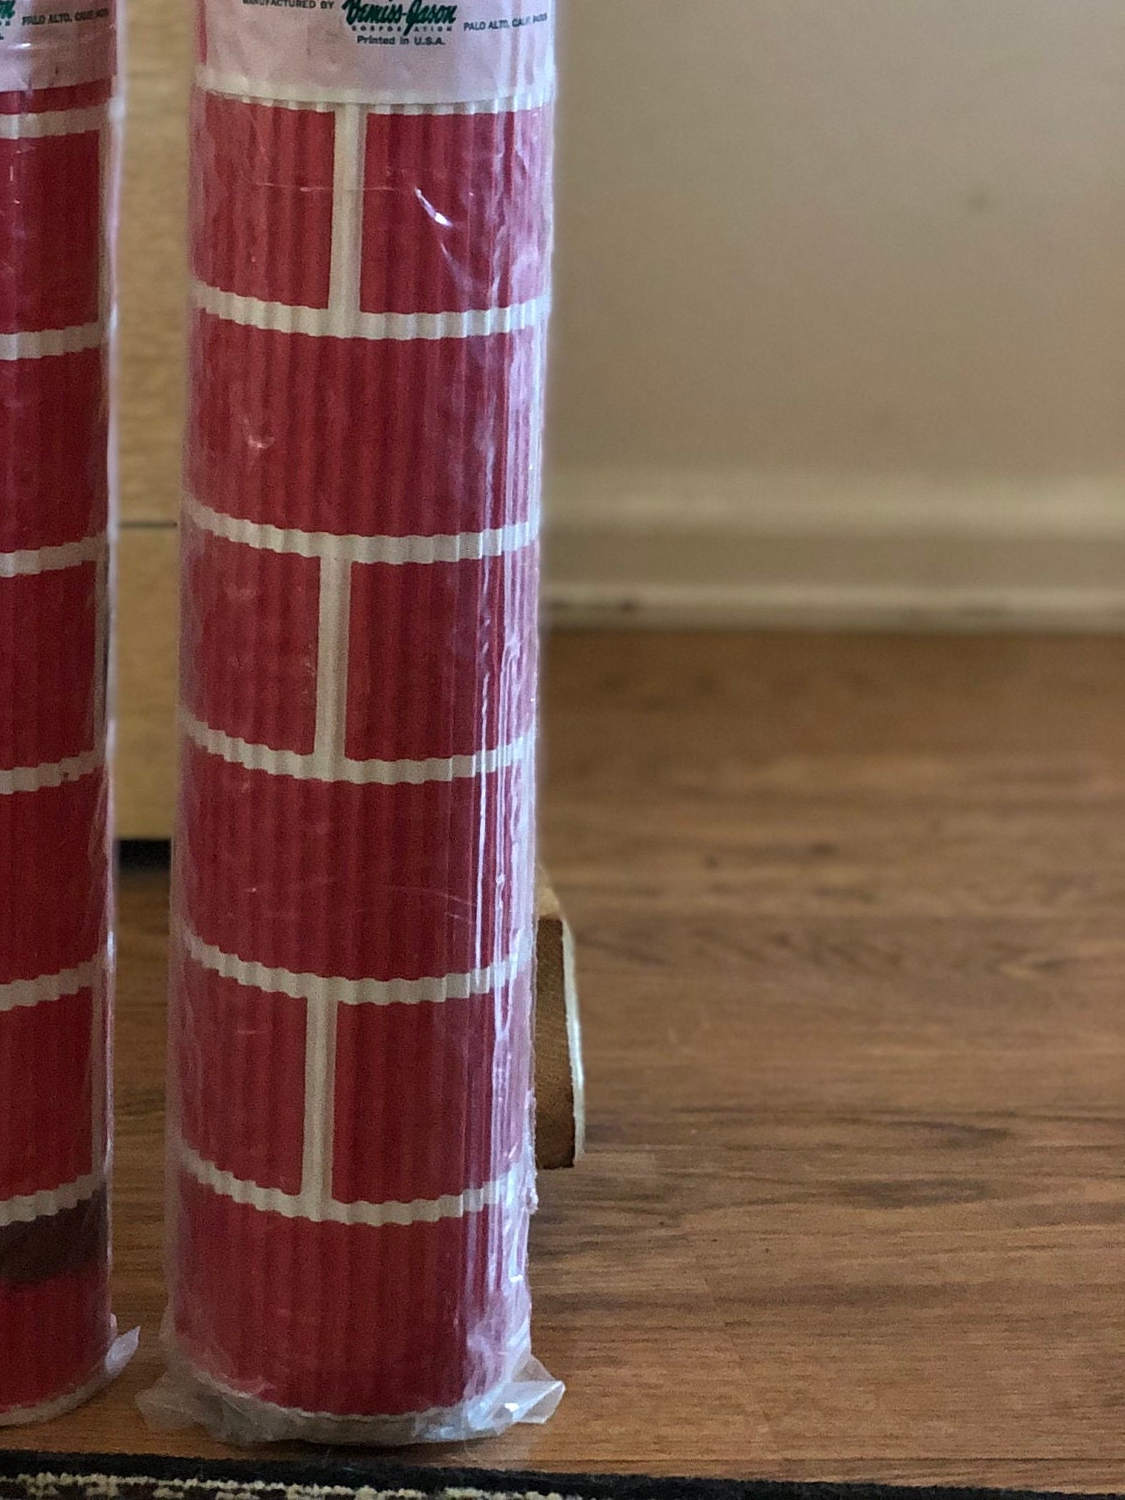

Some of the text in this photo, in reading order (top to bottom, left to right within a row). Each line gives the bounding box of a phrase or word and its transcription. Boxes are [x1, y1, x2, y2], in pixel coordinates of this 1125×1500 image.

[320, 0, 335, 9] BY
[463, 21, 486, 31] PALO
[357, 35, 446, 46] Printed in U.S.A.
